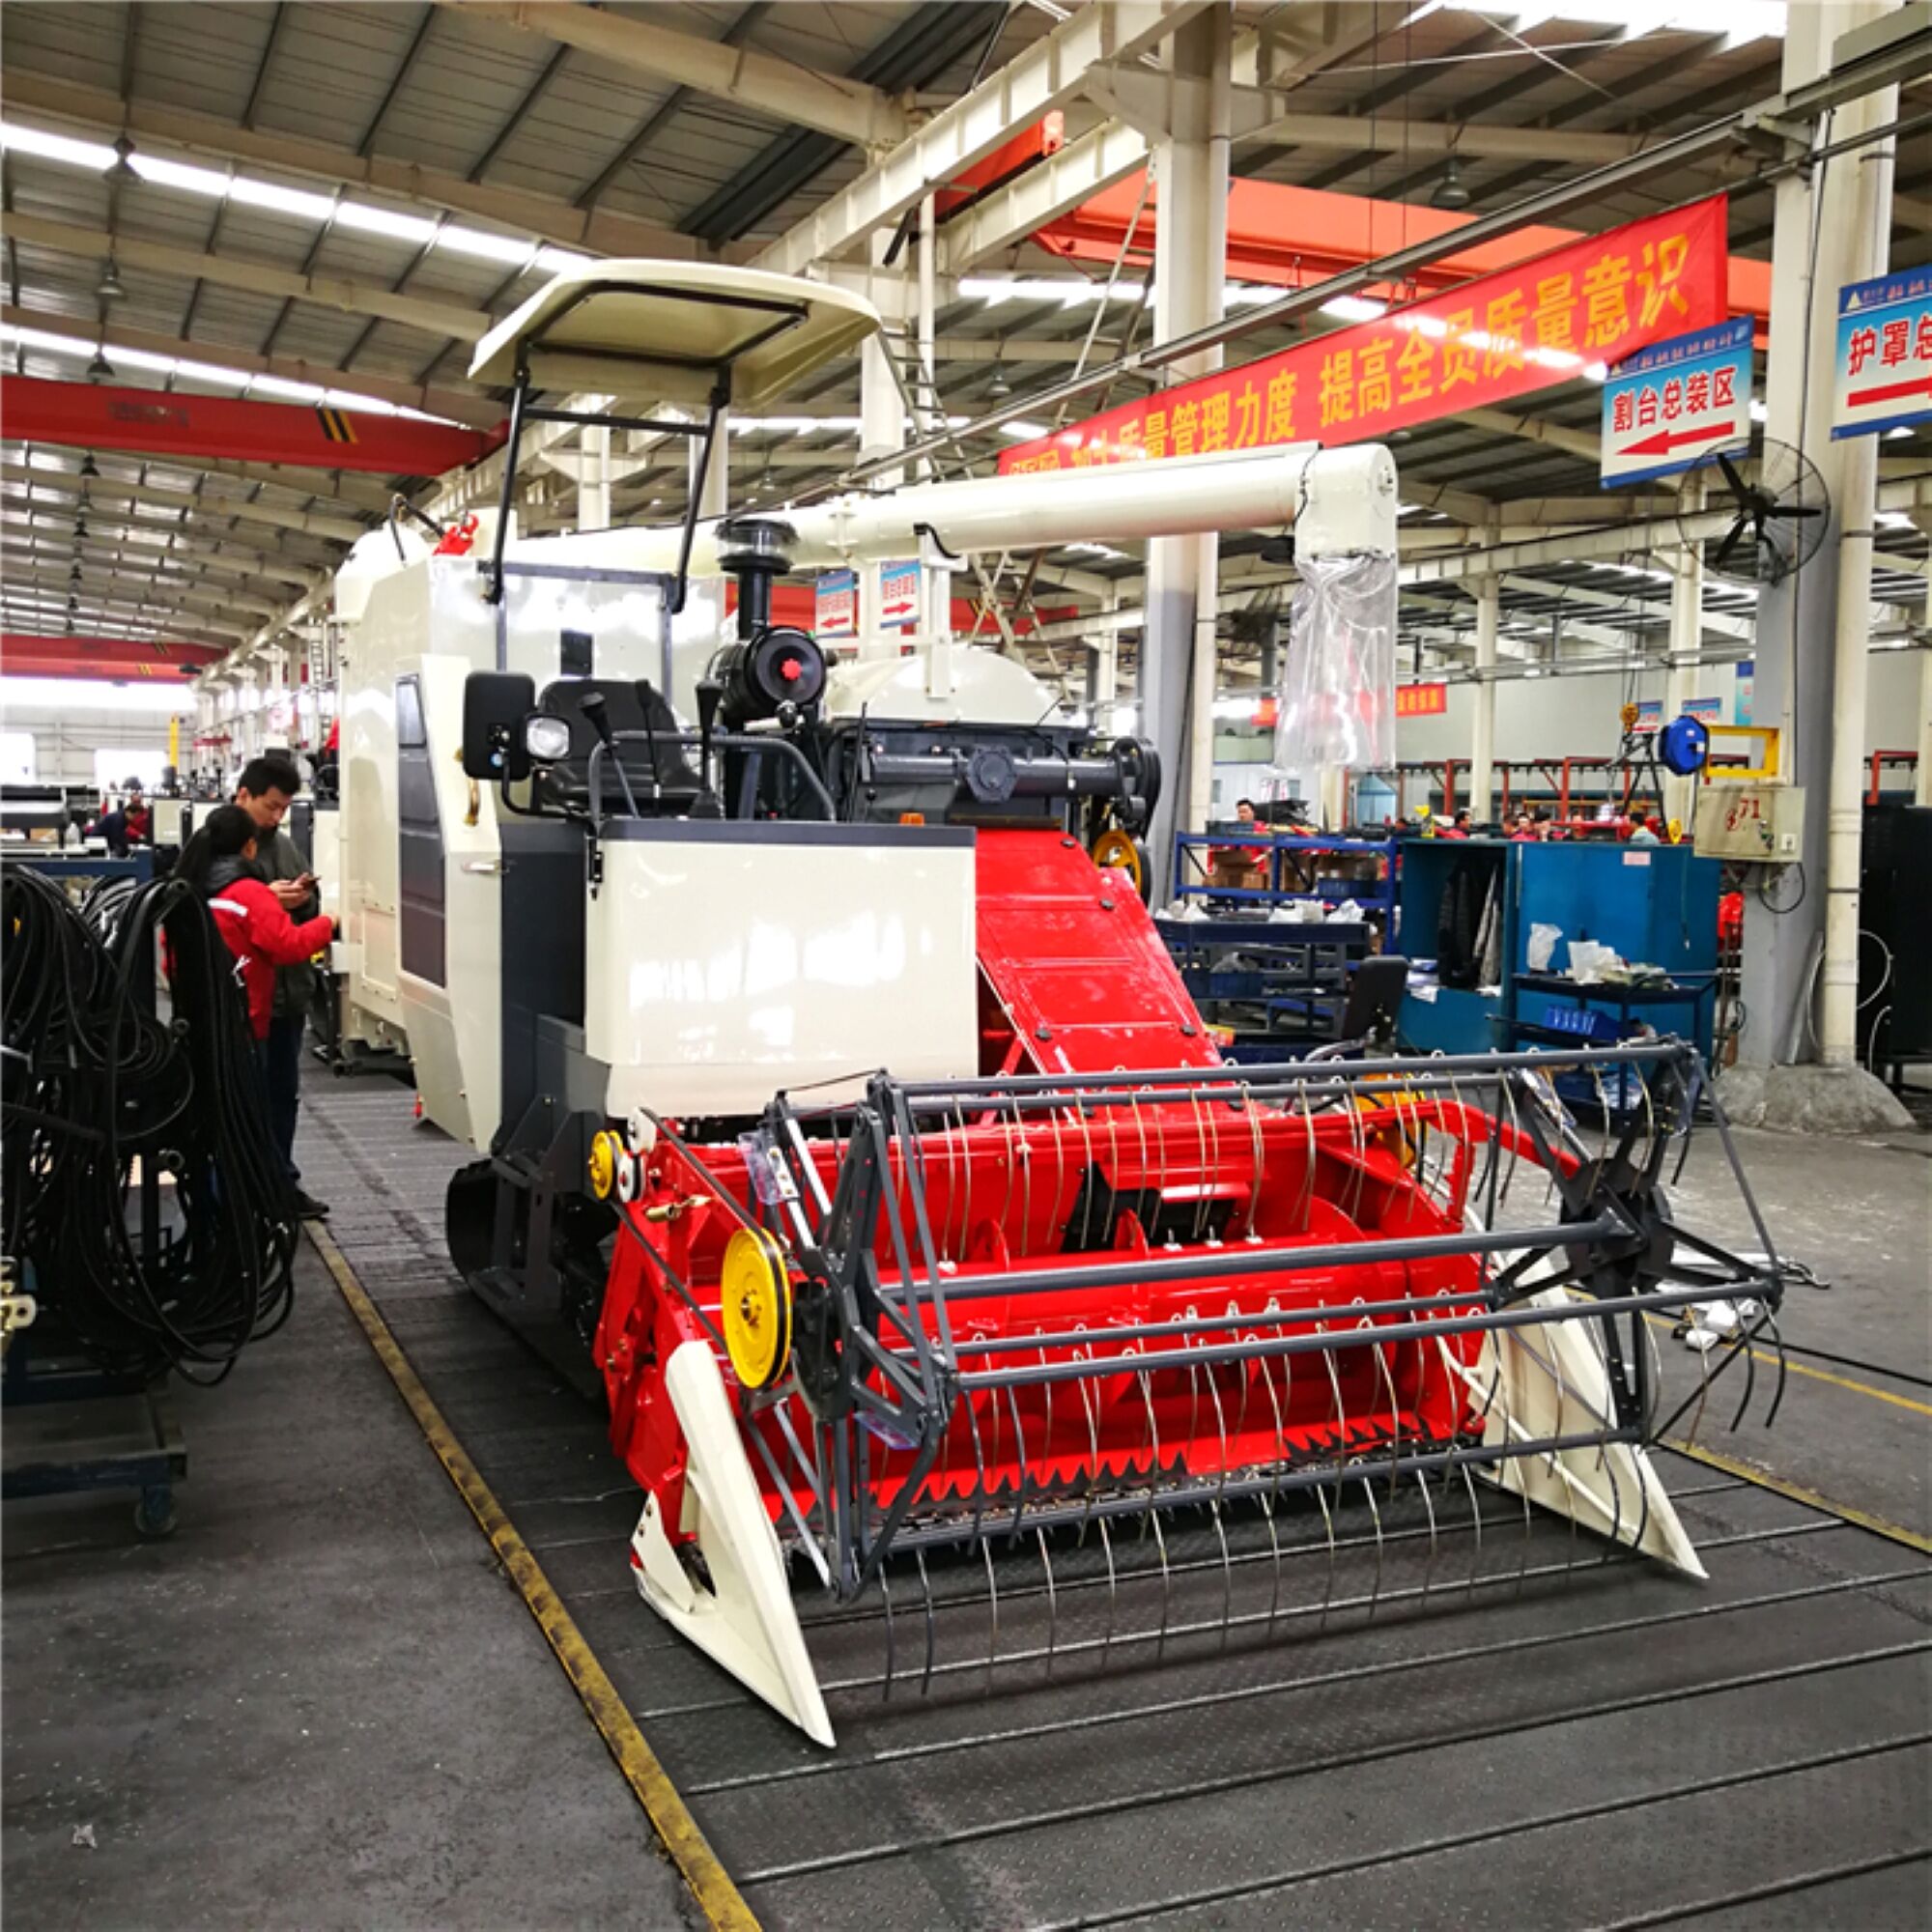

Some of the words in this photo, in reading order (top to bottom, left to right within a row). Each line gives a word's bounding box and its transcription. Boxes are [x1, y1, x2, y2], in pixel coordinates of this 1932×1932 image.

[1319, 233, 1690, 428] 提高全员质量意识
[1612, 364, 1737, 434] 割台总装区
